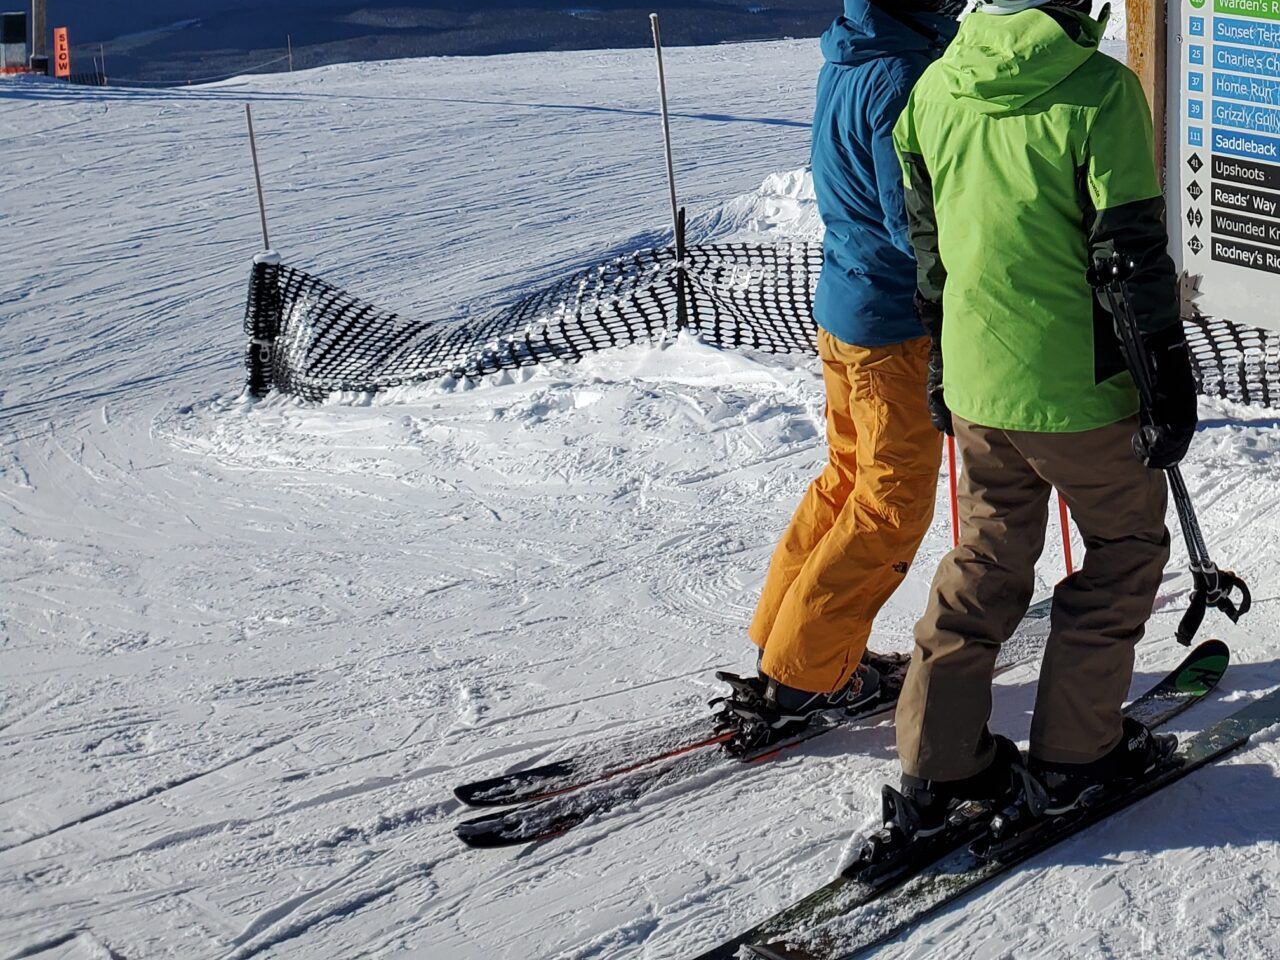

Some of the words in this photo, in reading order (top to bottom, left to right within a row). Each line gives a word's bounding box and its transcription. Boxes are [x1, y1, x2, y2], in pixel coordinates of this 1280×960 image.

[1192, 21, 1201, 31] 23
[1217, 24, 1254, 40] Sunset
[58, 33, 68, 71] SLOW
[1192, 49, 1201, 59] 25
[1217, 51, 1263, 69] Charlie's
[1191, 77, 1200, 86] 37
[1216, 79, 1248, 96] Home
[1251, 84, 1272, 98] Run
[1191, 104, 1200, 114] 39
[1216, 107, 1252, 126] Grizzly
[1190, 132, 1201, 141] 111
[1215, 134, 1277, 157] Saddleback
[1190, 158, 1199, 167] 41
[1215, 163, 1265, 182] Upshoots
[1189, 186, 1201, 196] 110
[1215, 192, 1249, 207] Reads'
[1253, 197, 1277, 215] Way
[1216, 216, 1265, 238] Wounded
[1189, 240, 1202, 250] 123
[1215, 243, 1263, 266] Rodney's
